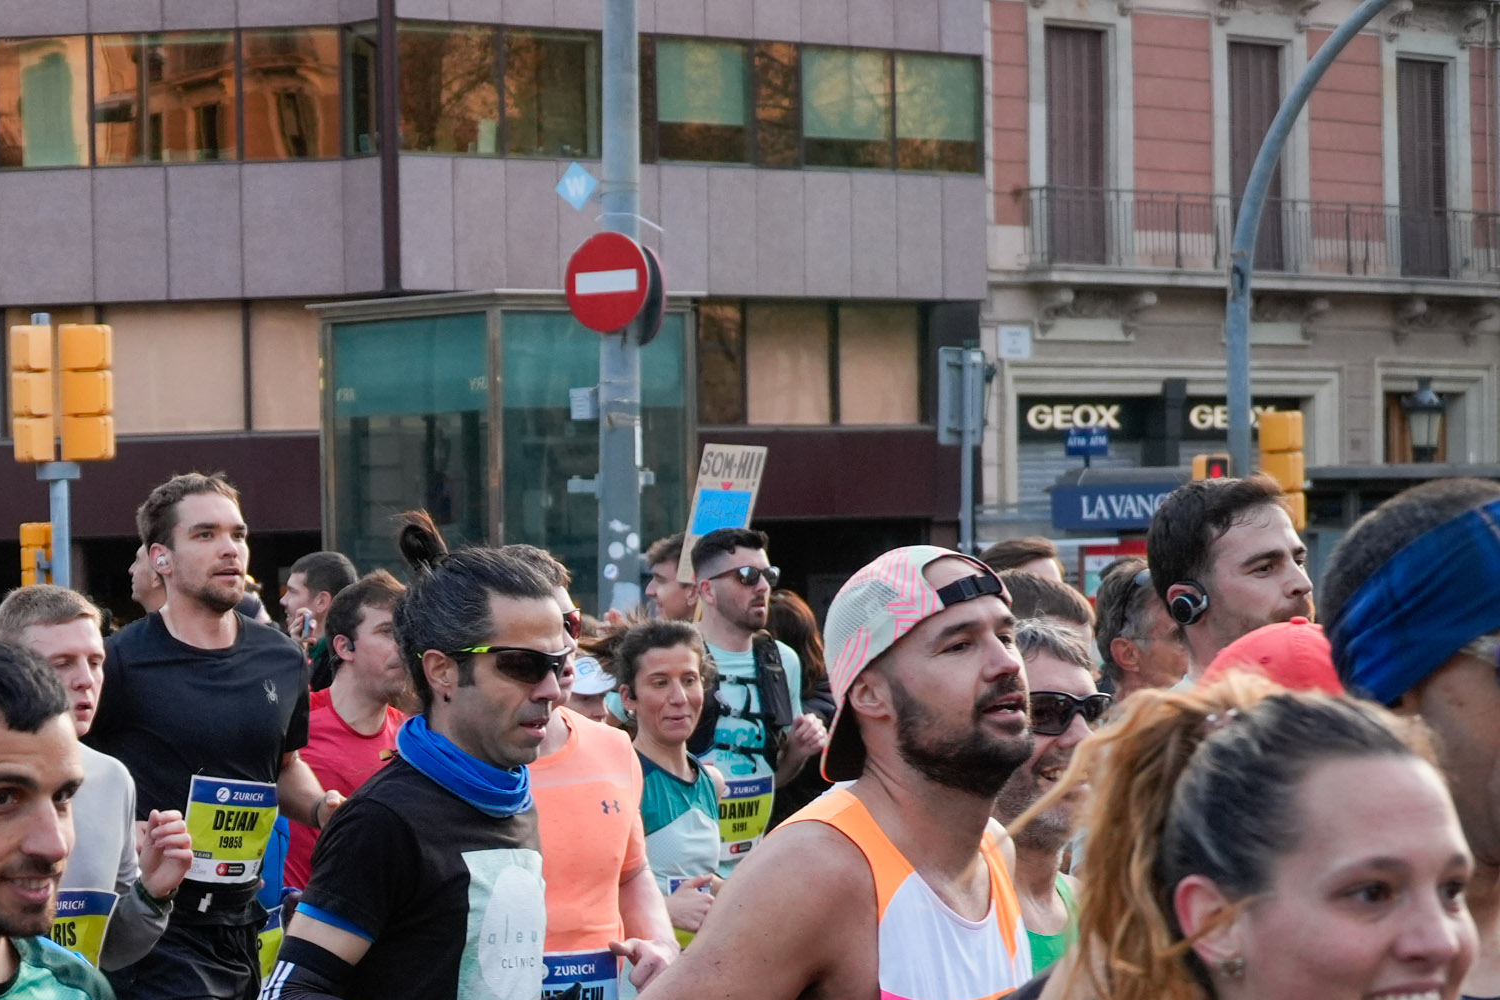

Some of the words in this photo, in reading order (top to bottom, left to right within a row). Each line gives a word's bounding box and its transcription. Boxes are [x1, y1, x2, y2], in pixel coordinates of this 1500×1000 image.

[1026, 404, 1120, 430] GEOX
[1081, 495, 1109, 520] LA
[232, 791, 263, 801] ZURICH
[733, 784, 760, 794] ZURICH
[719, 800, 760, 820] DANNY
[212, 809, 260, 832] DEJAN
[55, 900, 85, 910] URICH
[53, 921, 77, 947] RIS
[554, 963, 595, 977] ZURICH
